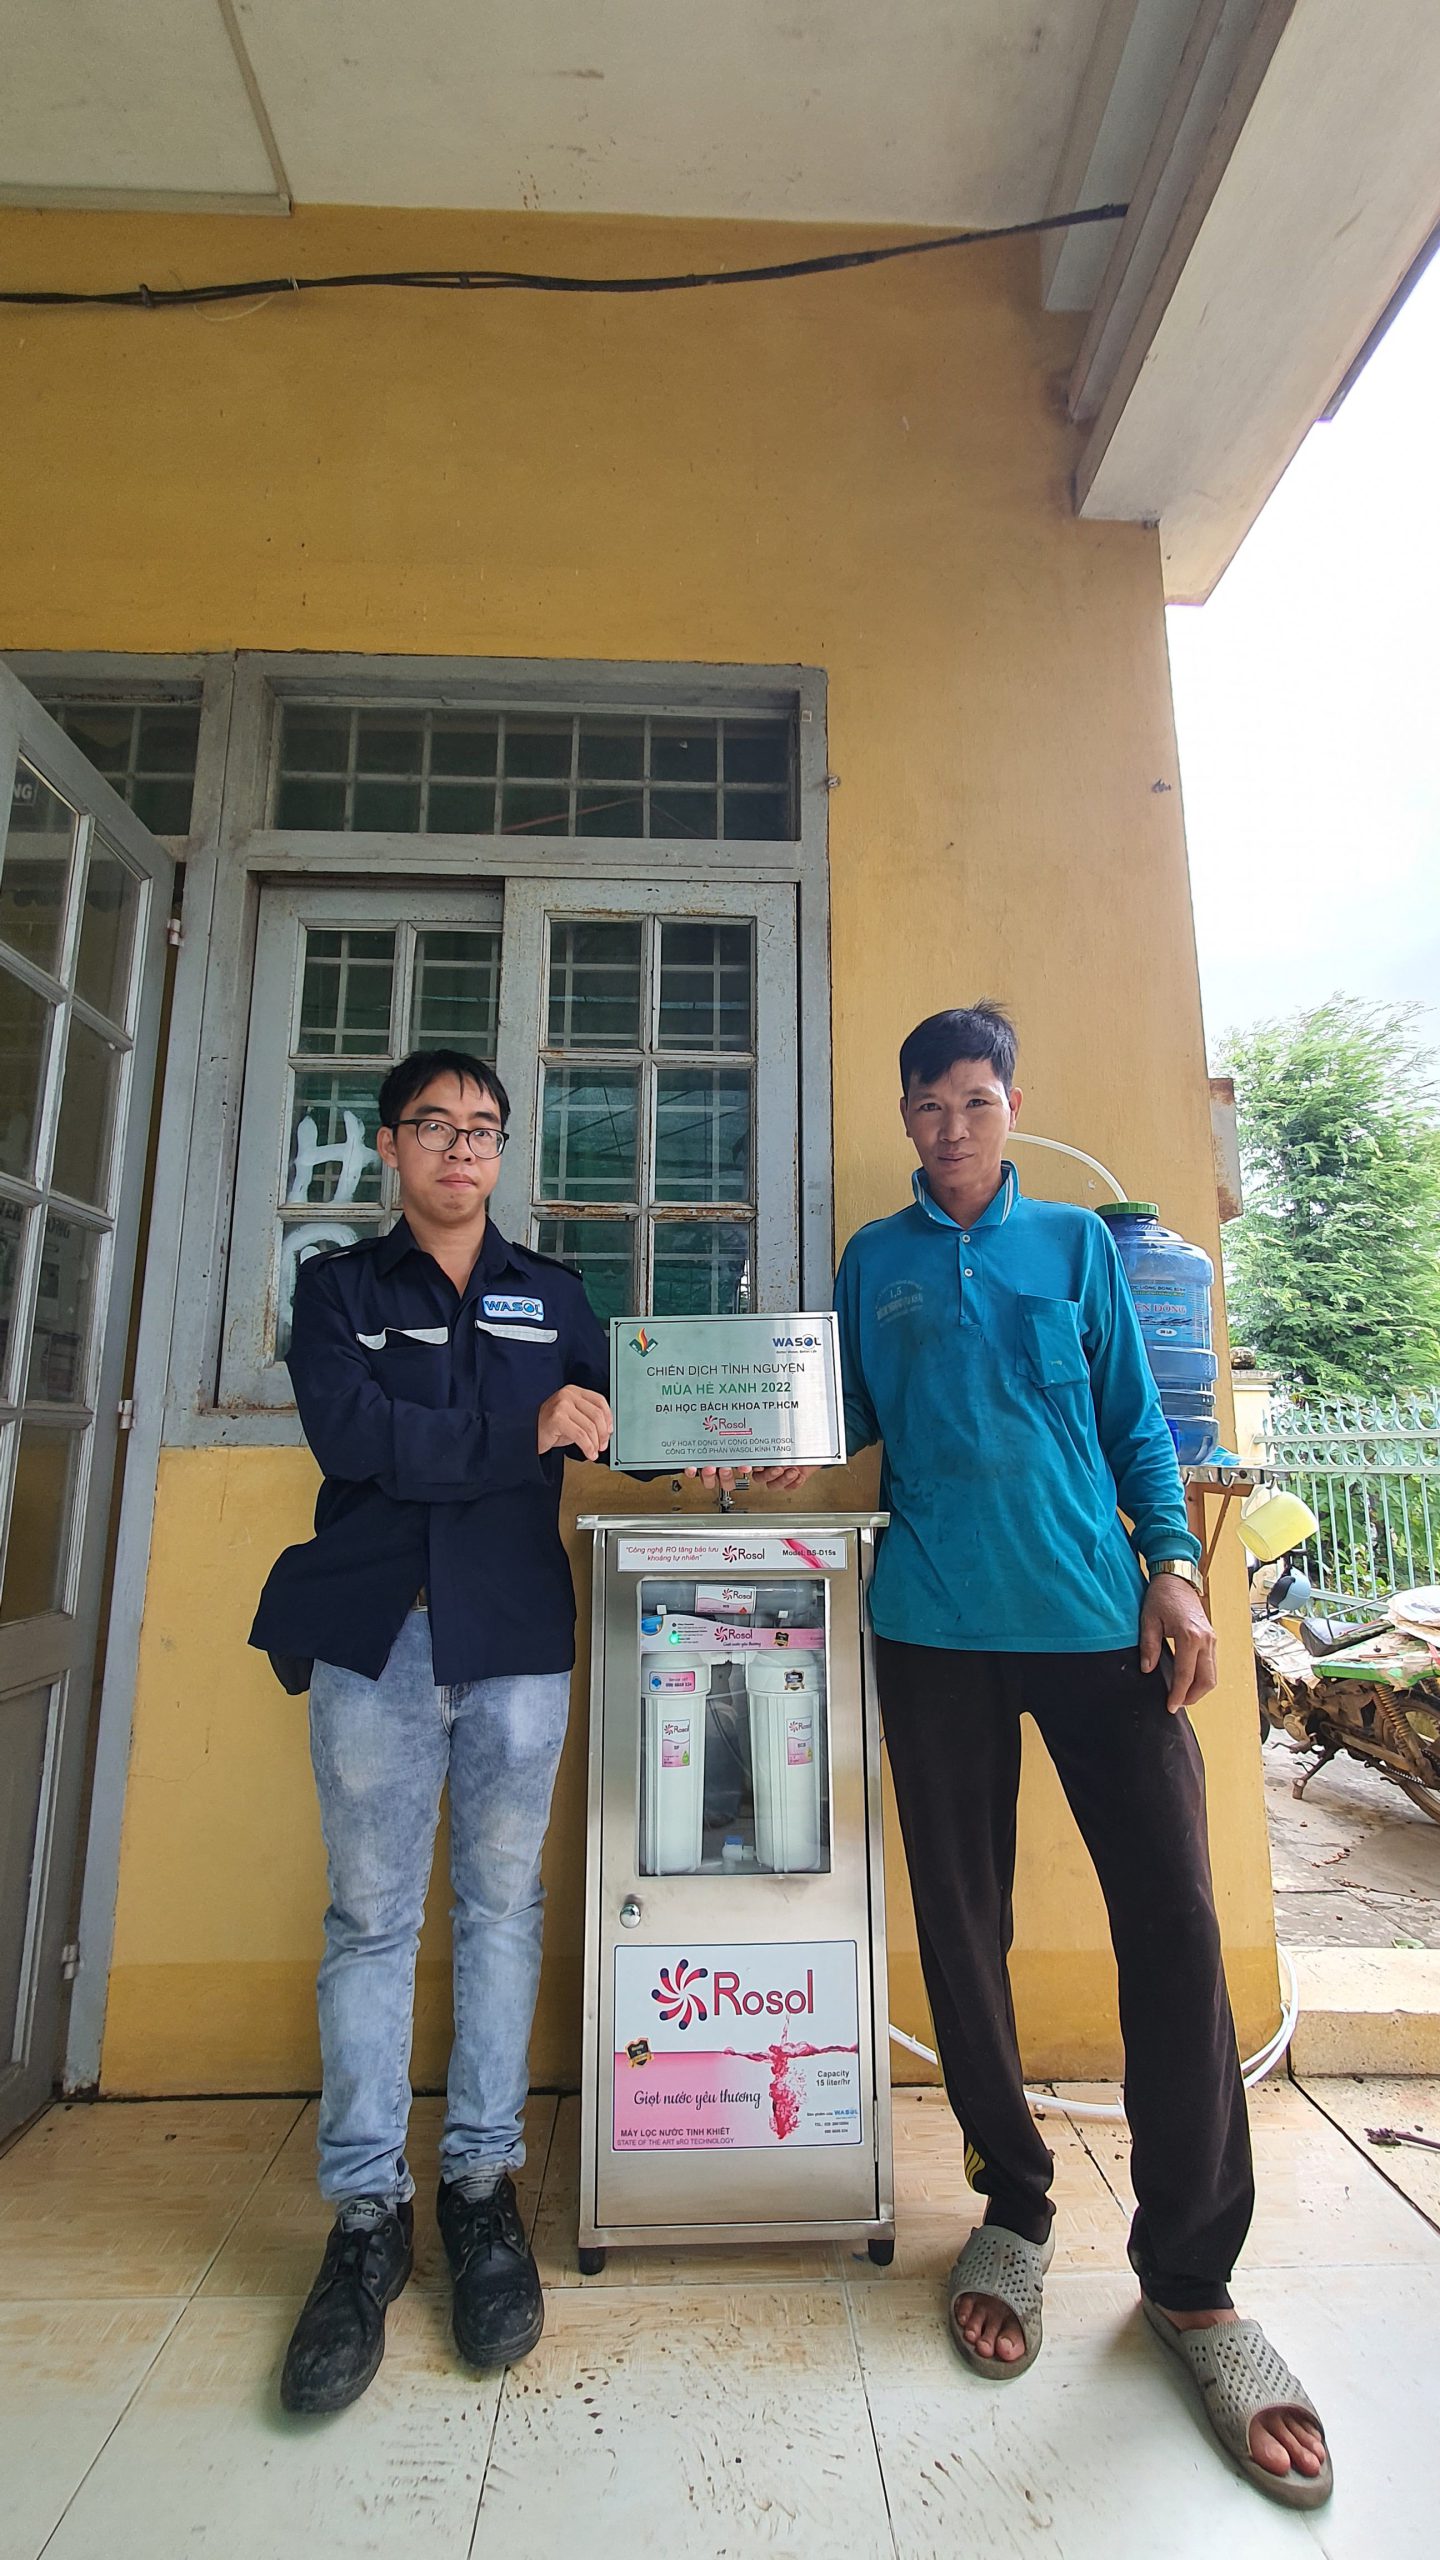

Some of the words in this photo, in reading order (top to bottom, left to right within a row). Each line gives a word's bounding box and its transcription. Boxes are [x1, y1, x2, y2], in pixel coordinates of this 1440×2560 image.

[485, 1300, 544, 1316] WASOL
[772, 1335, 822, 1349] WASOL
[646, 1363, 685, 1377] CHIẾN
[688, 1365, 718, 1377] DỊCH
[721, 1362, 750, 1375] TÌNH
[753, 1361, 805, 1375] NGUYỆN
[661, 1382, 692, 1395] MÙA
[696, 1381, 714, 1394] HÈ
[719, 1382, 757, 1394] XANH
[761, 1381, 791, 1393] 2022
[655, 1404, 673, 1414] ĐẠI
[675, 1403, 697, 1413] HỌC
[700, 1401, 729, 1411] BÁCH
[731, 1401, 760, 1411] KHOA
[762, 1400, 799, 1410] TP.HCM
[718, 1417, 746, 1429] Rosol
[665, 1447, 686, 1455] CÔNG
[738, 1548, 765, 1560] Rosol
[733, 1589, 753, 1600] Rosol
[728, 1628, 753, 1639] Rosol
[713, 1969, 814, 2016] Rosol
[817, 2069, 850, 2079] Capacity
[816, 2079, 825, 2087] 15
[633, 2089, 661, 2107] Giọt
[663, 2091, 694, 2105] nước
[695, 2090, 717, 2110] yêu
[719, 2088, 761, 2109] thương
[620, 2128, 639, 2137] MÁY
[640, 2128, 657, 2137] LỌC
[659, 2127, 684, 2137] NƯỚC
[686, 2127, 705, 2136] TINH
[706, 2126, 731, 2136] KHIẾT
[617, 2138, 637, 2146] STATE
[637, 2138, 647, 2146] OF
[648, 2138, 661, 2146] THE
[690, 2137, 735, 2145] TECHNOLOGY
